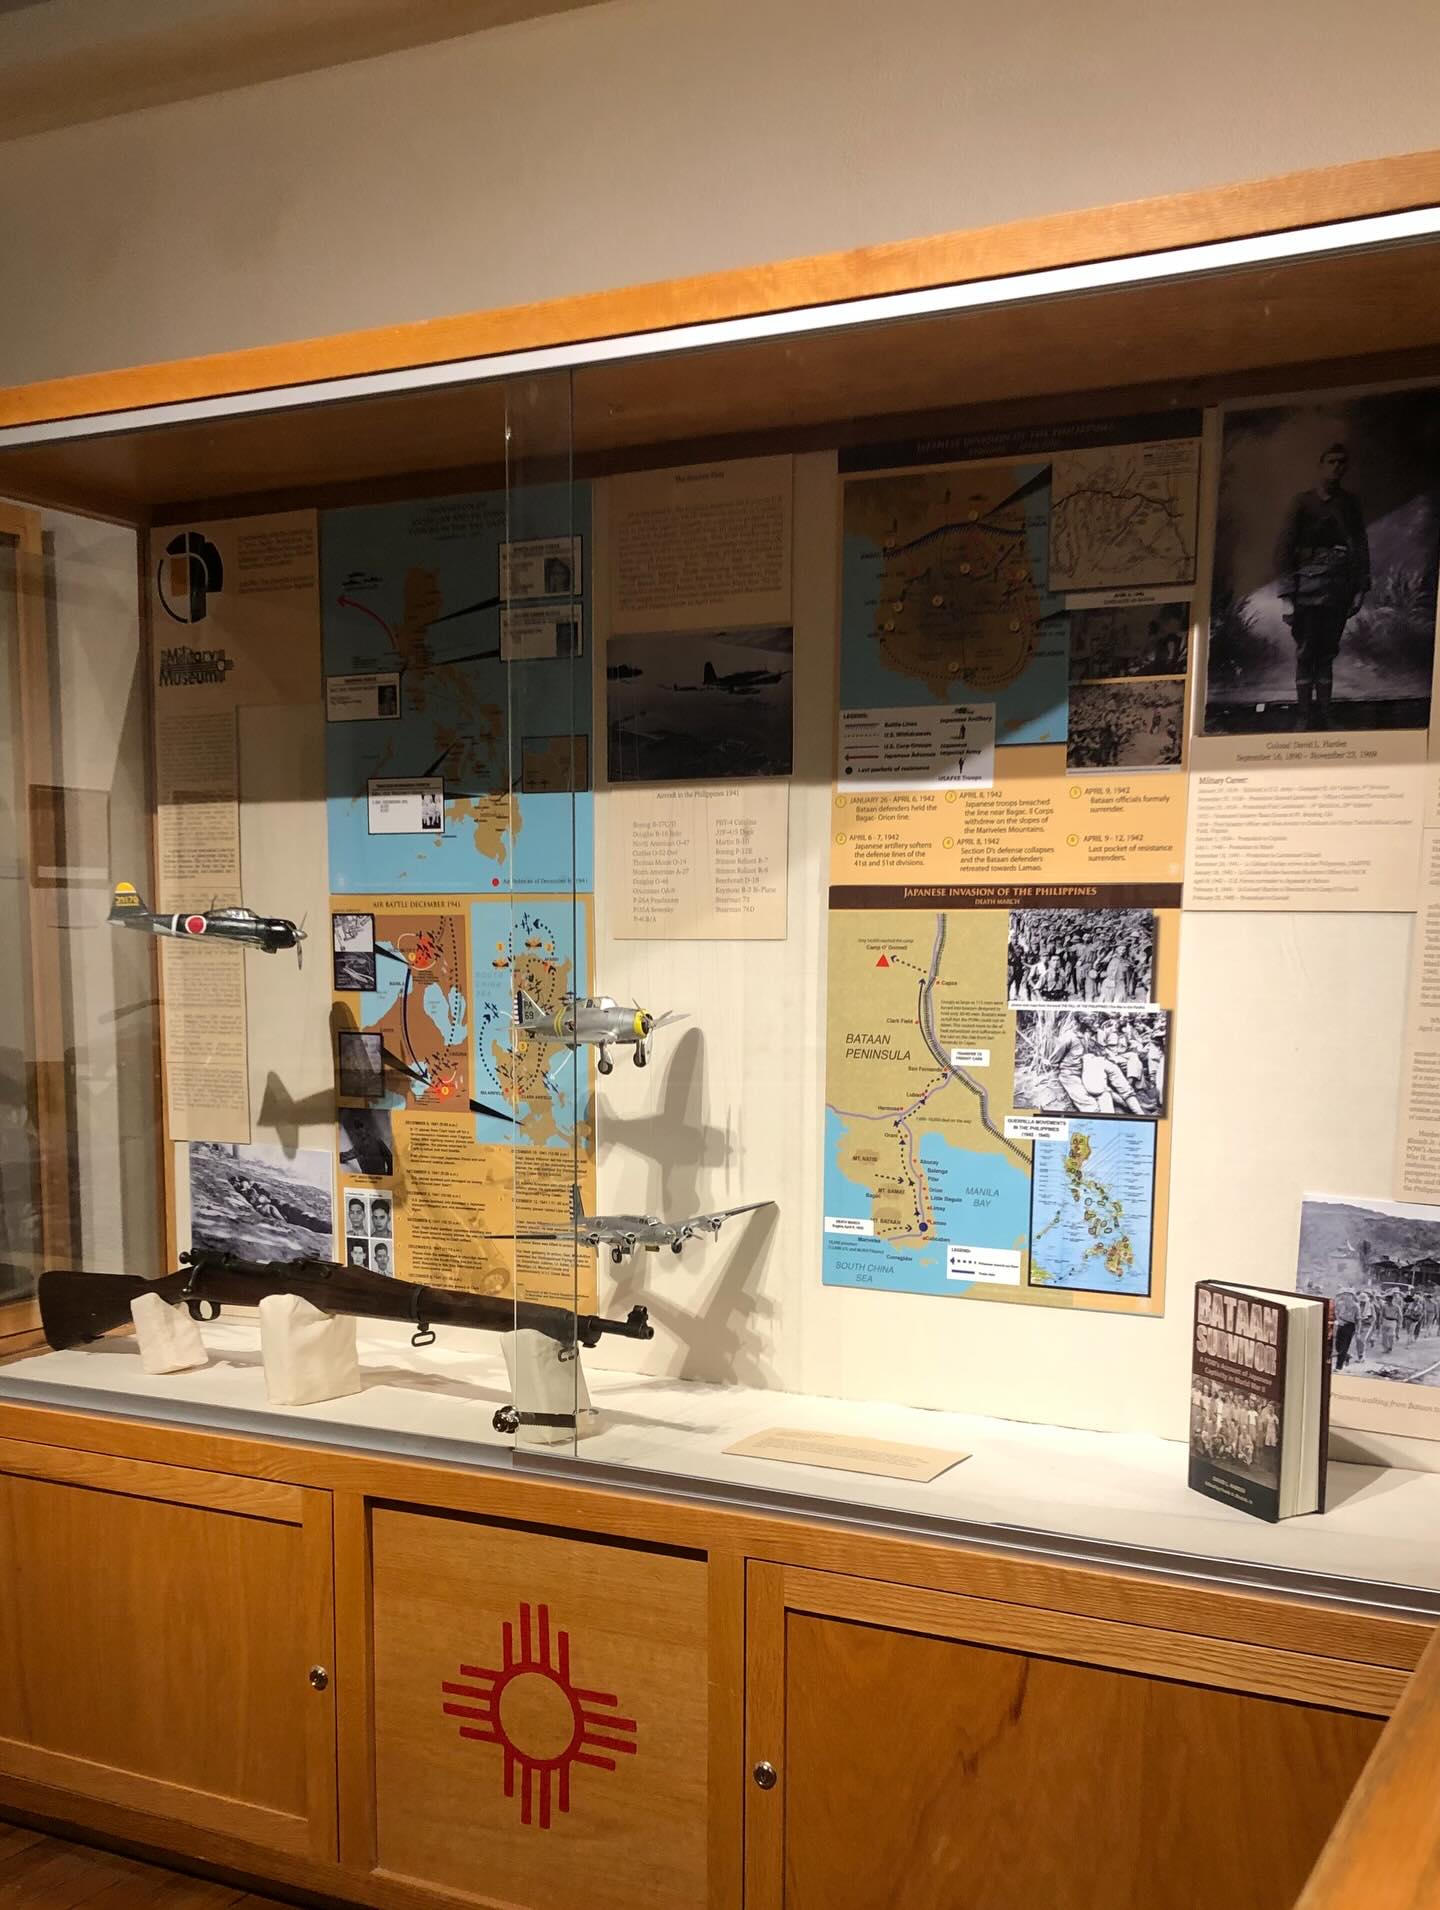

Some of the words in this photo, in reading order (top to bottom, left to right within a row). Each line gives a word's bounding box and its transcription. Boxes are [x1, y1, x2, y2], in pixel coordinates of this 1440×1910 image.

[160, 671, 218, 687] Museum
[940, 716, 967, 724] Japanese
[968, 715, 993, 723] Artillery
[884, 752, 910, 760] Japanese
[1236, 754, 1271, 762] September
[1310, 750, 1345, 759] November
[871, 766, 894, 774] pockets
[1199, 777, 1225, 786] Military
[656, 791, 677, 799] Aircraft
[694, 790, 724, 798] Philippines
[893, 795, 910, 803] APRIL
[965, 800, 994, 809] Japanese
[996, 800, 1017, 808] troops
[1019, 798, 1050, 806] breached
[1115, 796, 1142, 804] officials
[856, 805, 878, 813] Bataan
[878, 805, 909, 813] defenders
[911, 804, 925, 812] held
[1033, 808, 1054, 816] Corps
[897, 813, 909, 821] line.
[1019, 817, 1040, 826] slopes
[1040, 816, 1049, 824] of
[877, 834, 883, 842] 7,
[1127, 834, 1144, 842] 1942
[854, 842, 884, 850] Japanese
[884, 842, 908, 850] artillery
[908, 841, 932, 849] softens
[1088, 845, 1102, 853] Last
[1103, 845, 1128, 853] pocket
[907, 850, 914, 858] of
[914, 850, 926, 858] the
[961, 847, 985, 855] Section
[1023, 846, 1054, 854] collapses
[1009, 855, 1043, 863] defenders
[1088, 854, 1126, 862] surrenders.
[868, 859, 880, 867] and
[1018, 864, 1042, 872] Lamao.
[904, 887, 947, 899] JAPANESE
[949, 887, 995, 897] INVASION
[997, 887, 1010, 896] OF
[1012, 887, 1032, 896] THE
[1035, 887, 1097, 896] PHILIPPINES
[373, 900, 383, 908] AIR
[385, 900, 408, 908] BATTLE
[409, 900, 446, 908] DECEMBER
[447, 900, 461, 908] 1941
[525, 1012, 534, 1020] 69
[845, 1033, 891, 1045] BATAAN
[845, 1049, 911, 1061] PENINSULA
[965, 1187, 1000, 1197] MANILA
[973, 1199, 991, 1208] BAY
[835, 1261, 870, 1272] SOUTH
[871, 1263, 895, 1274] CHINA
[856, 1273, 873, 1283] SEA
[1198, 1287, 1279, 1346] BATAAN
[1196, 1324, 1277, 1376] SURVIVOR
[1361, 1397, 1389, 1407] walking
[1390, 1400, 1406, 1408] from
